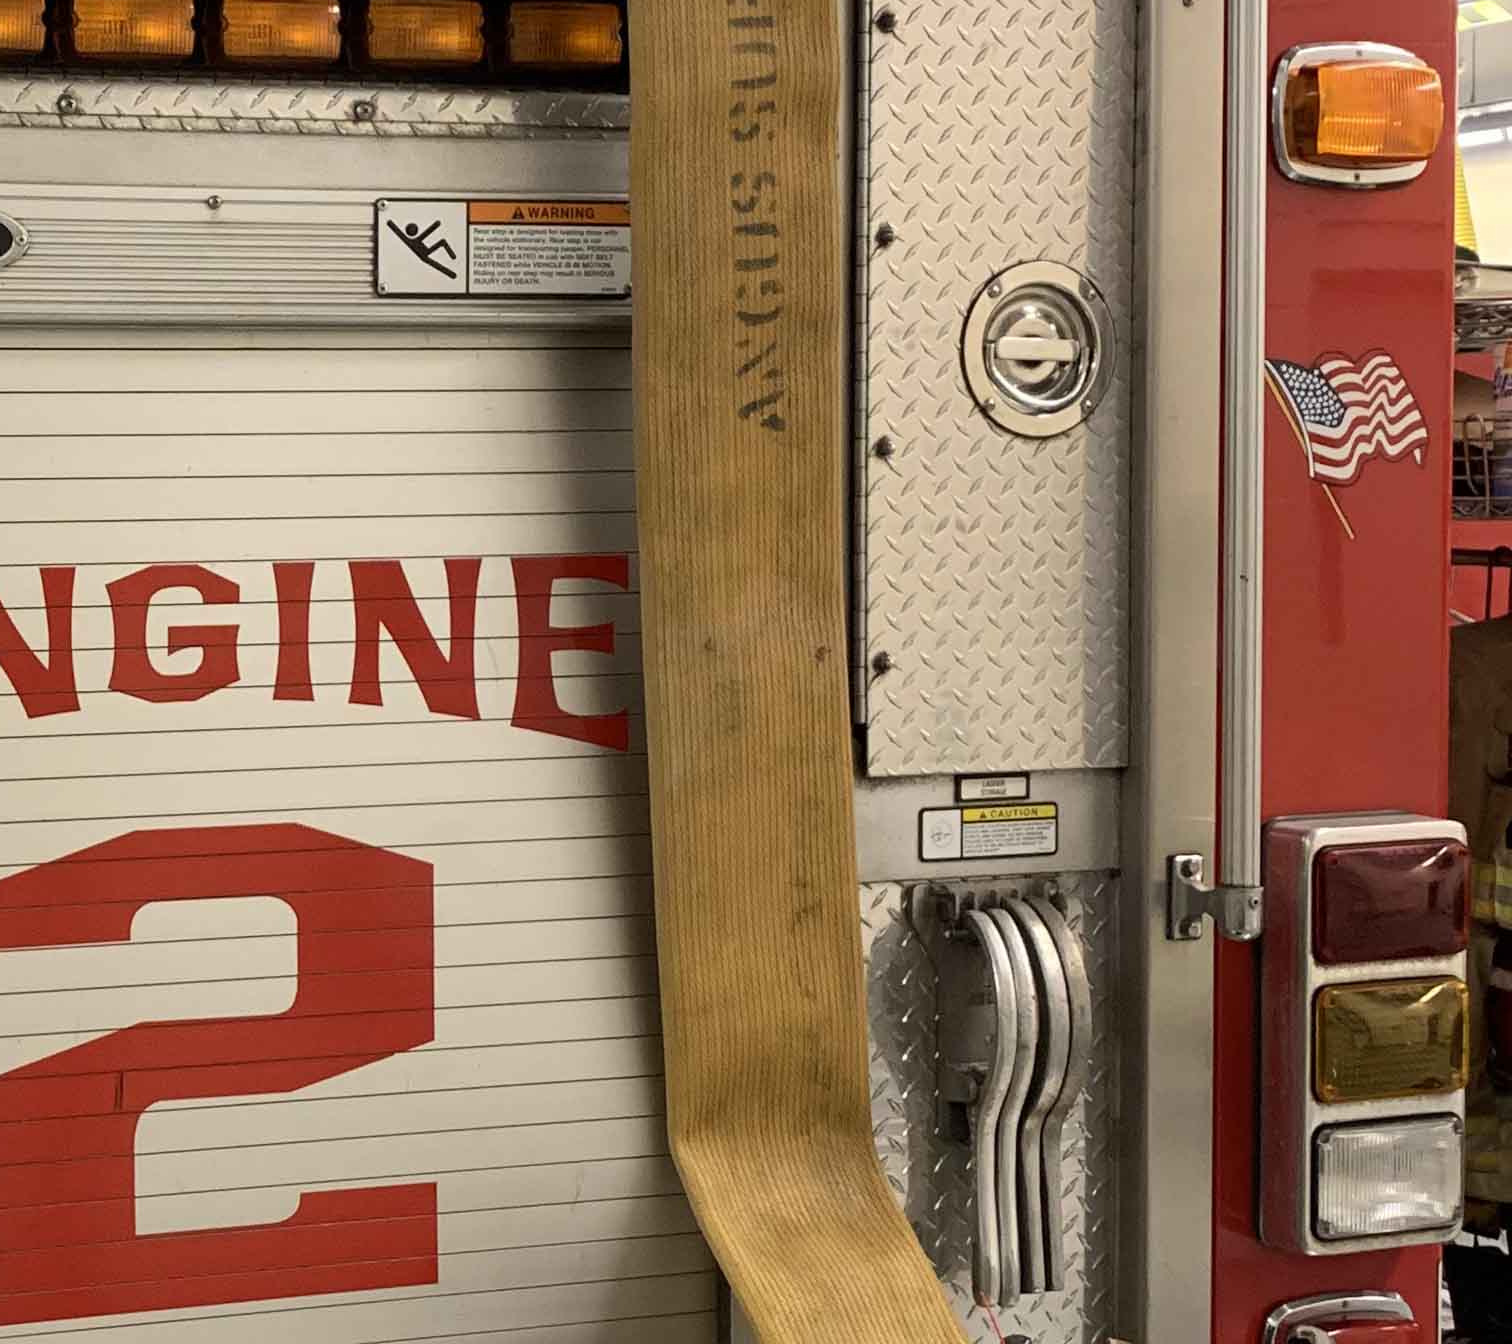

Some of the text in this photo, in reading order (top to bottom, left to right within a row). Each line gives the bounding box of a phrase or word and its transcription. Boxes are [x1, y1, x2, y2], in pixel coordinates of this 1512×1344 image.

[527, 206, 596, 221] WARNING
[728, 169, 787, 432] ANGUS
[990, 808, 1038, 818] CAUTION
